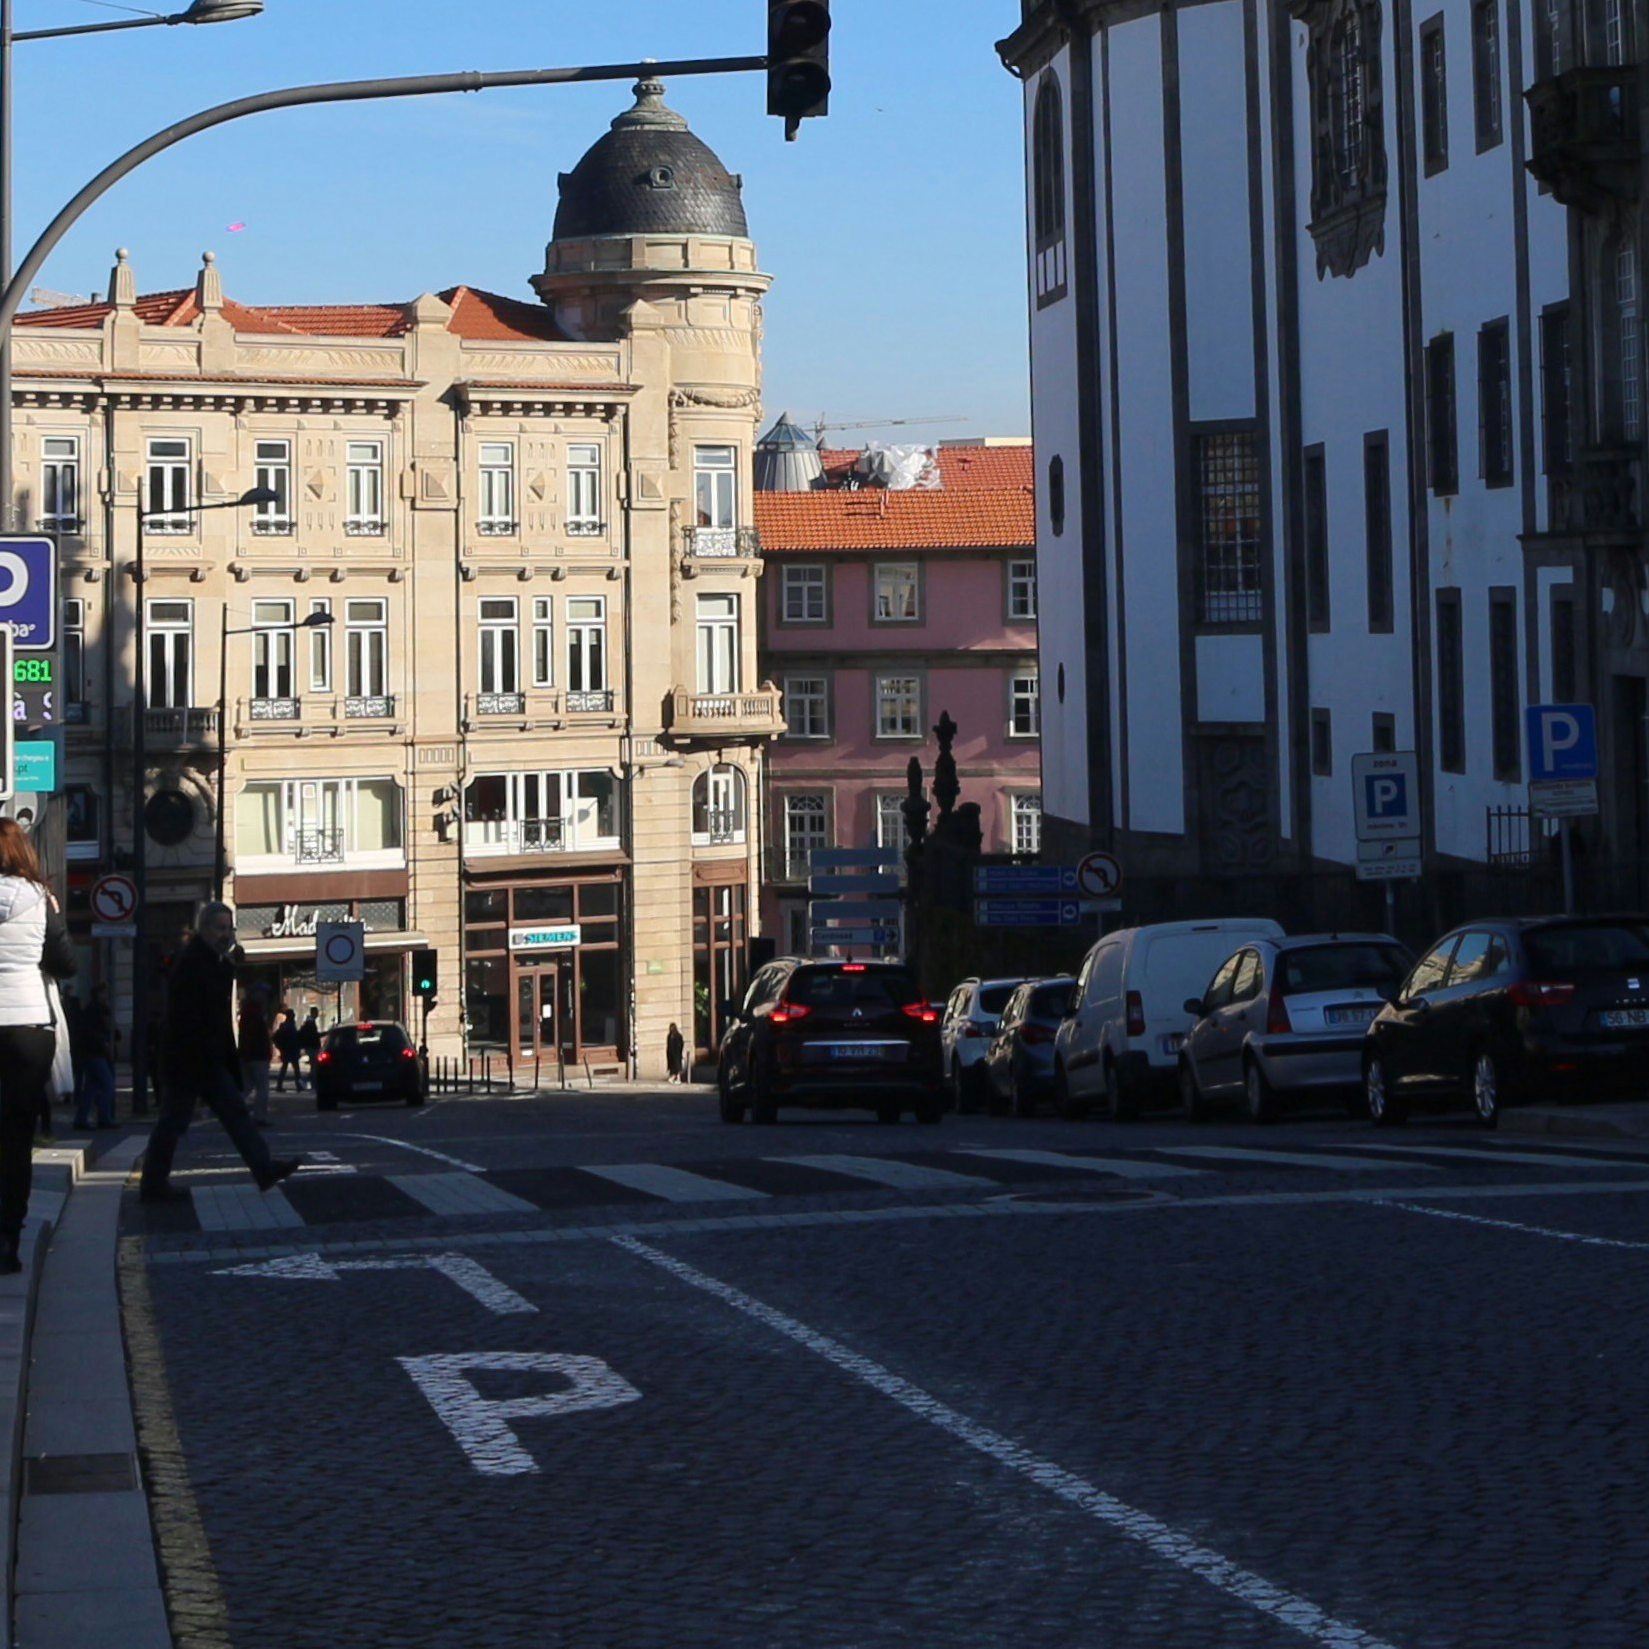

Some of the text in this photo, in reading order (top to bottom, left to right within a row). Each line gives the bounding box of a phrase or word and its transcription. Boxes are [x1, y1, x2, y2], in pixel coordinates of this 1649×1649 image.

[1541, 712, 1580, 772] P
[1373, 759, 1397, 768] zona
[1373, 779, 1398, 814] P
[525, 931, 577, 944] SIEMENS
[393, 1352, 643, 1475] P
